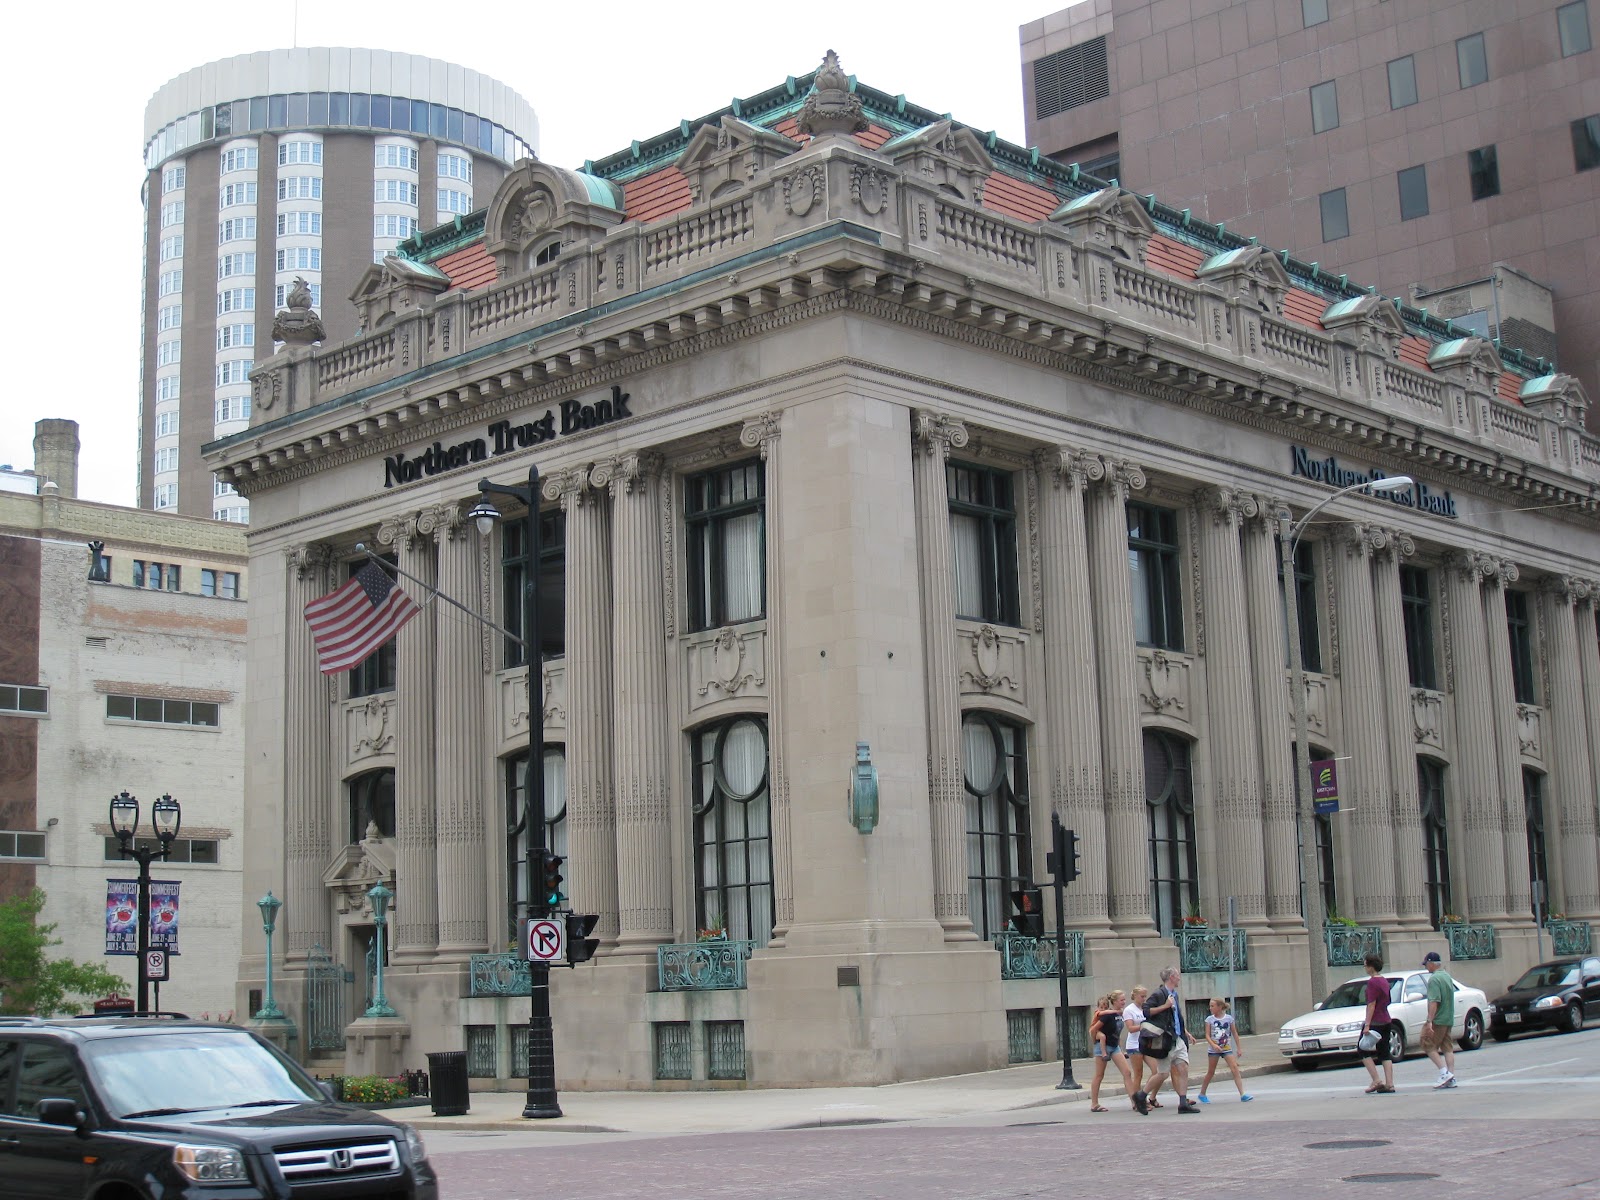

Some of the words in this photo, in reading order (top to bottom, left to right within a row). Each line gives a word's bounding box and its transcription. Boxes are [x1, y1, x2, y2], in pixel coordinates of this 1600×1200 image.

[383, 438, 487, 488] Northern
[488, 410, 556, 455] Trust
[559, 385, 633, 436] Bank
[1291, 445, 1370, 493] Northern
[1415, 482, 1459, 518] Bank
[107, 882, 137, 895] SUMMERFEST
[151, 883, 180, 896] SUMMERFEST
